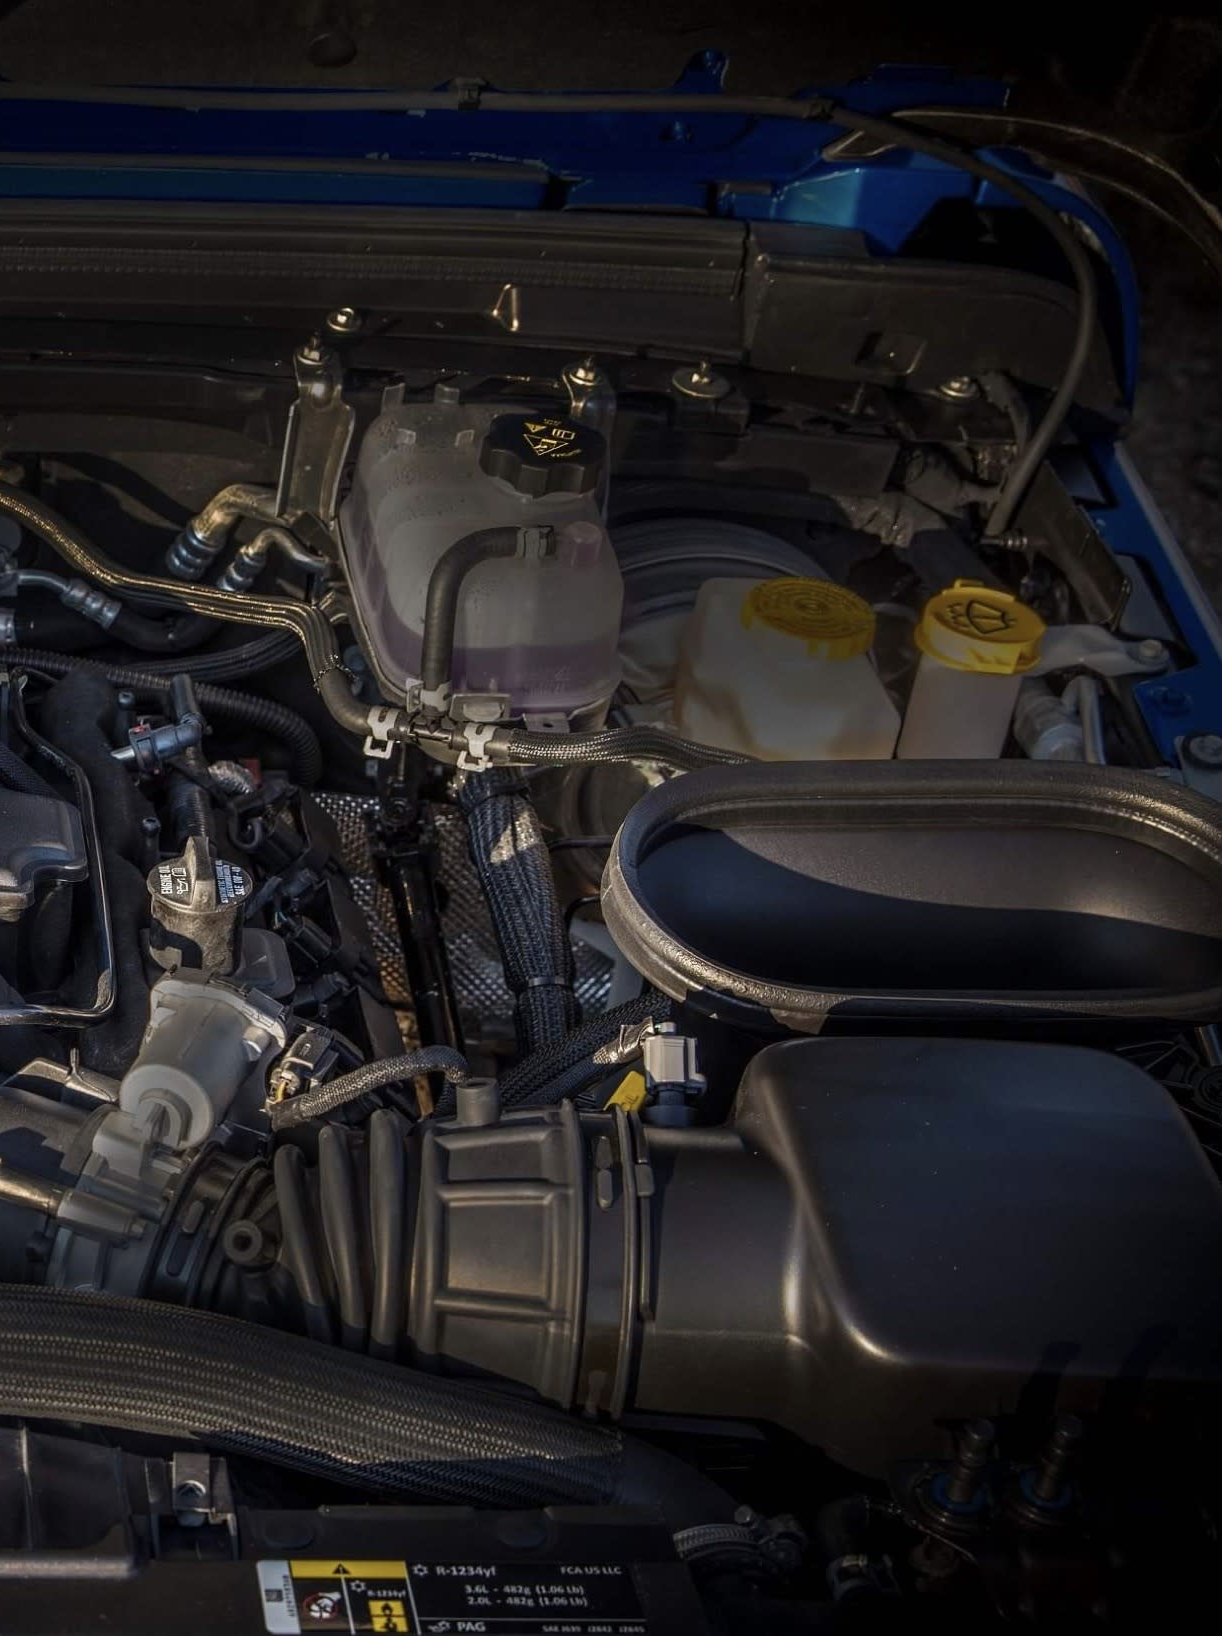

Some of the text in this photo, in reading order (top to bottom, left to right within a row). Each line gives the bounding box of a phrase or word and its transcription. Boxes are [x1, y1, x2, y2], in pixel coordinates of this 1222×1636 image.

[158, 865, 173, 894] ENGINE OIL
[234, 885, 245, 896] SAE
[435, 1565, 497, 1578] R-1234yf
[560, 1566, 623, 1575] FCA US LLC
[464, 1584, 489, 1595] 3.6L
[502, 1585, 532, 1596] 482g
[535, 1585, 563, 1595] (1.06
[467, 1596, 492, 1607] 2.0L
[505, 1596, 535, 1608] 482g
[538, 1596, 567, 1607] (1.06
[456, 1621, 487, 1633] PAG
